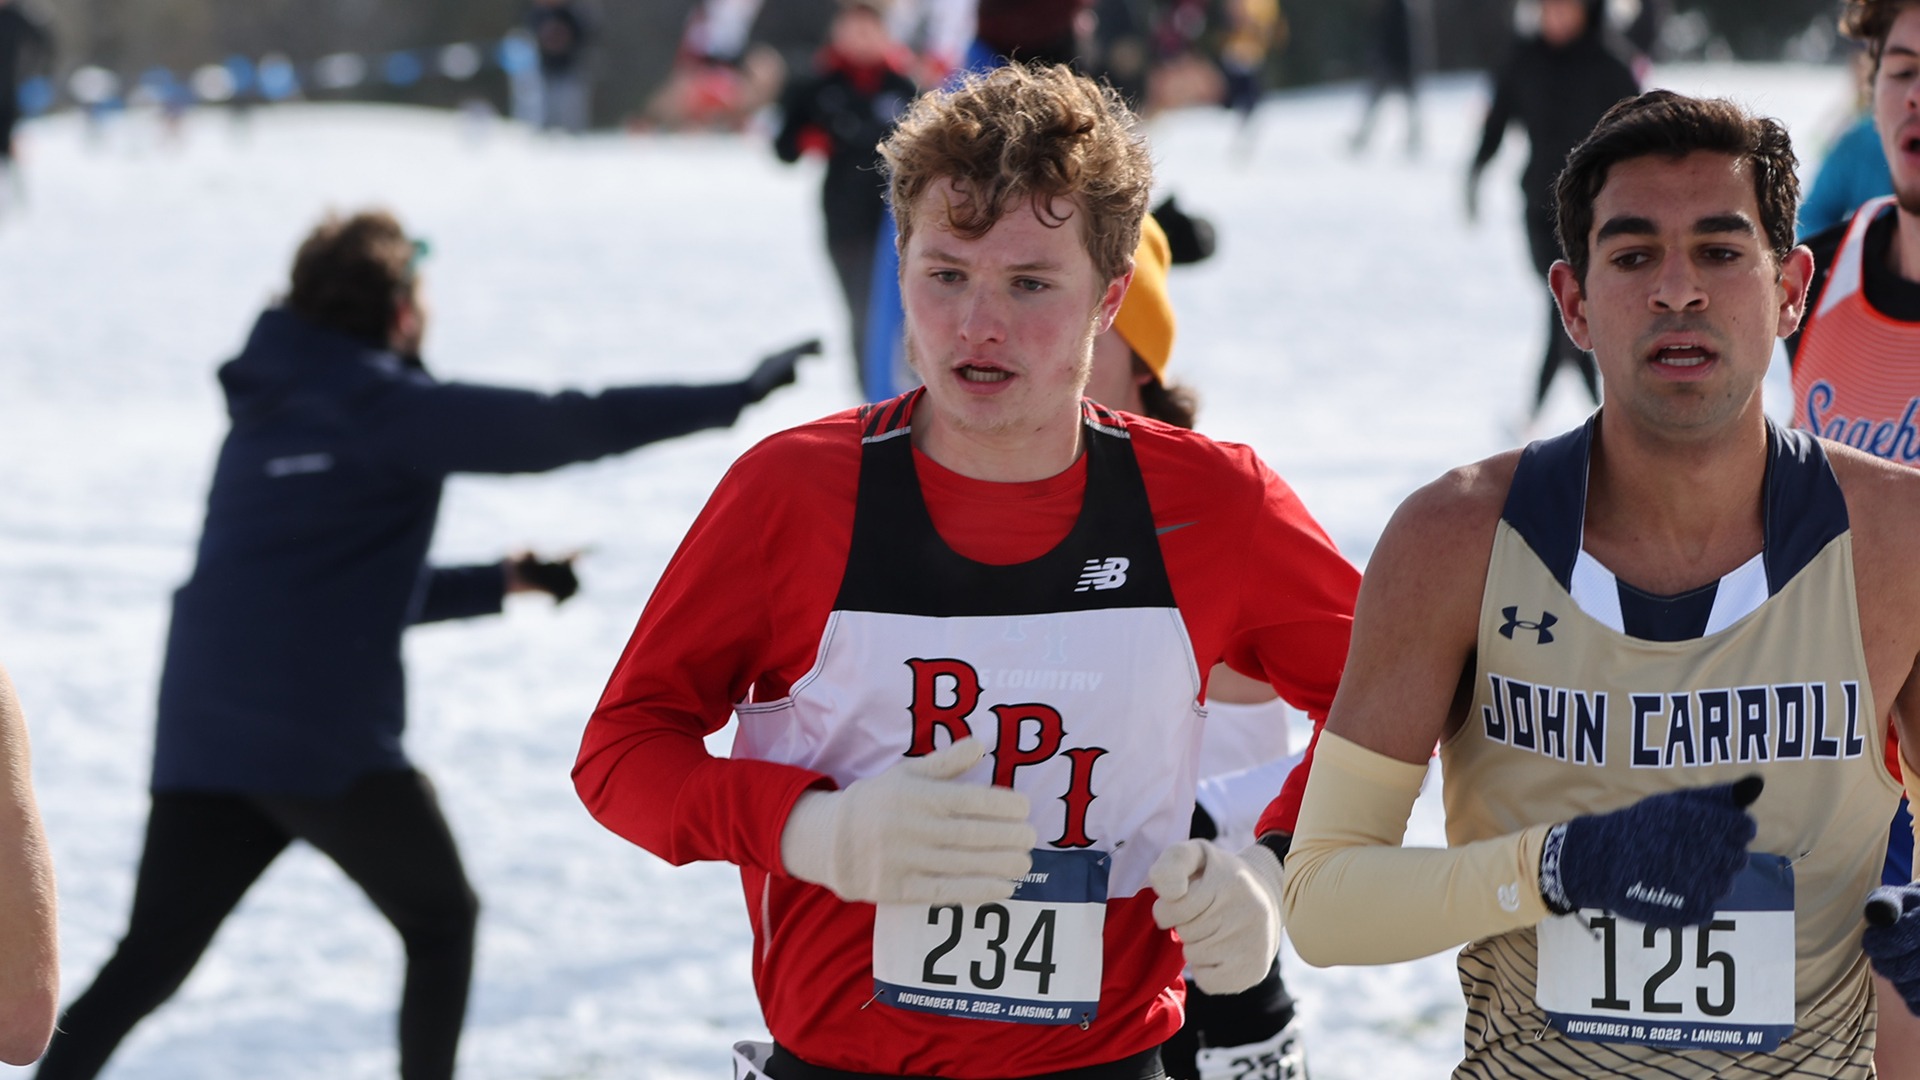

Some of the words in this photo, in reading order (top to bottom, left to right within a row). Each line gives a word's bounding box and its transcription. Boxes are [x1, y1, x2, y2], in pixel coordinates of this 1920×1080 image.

[903, 657, 1108, 849] RPI
[1481, 672, 1608, 767] JOHN
[1628, 680, 1866, 769] CARROLL
[921, 900, 1057, 995] 234
[1589, 915, 1737, 1017] 125
[897, 992, 954, 1010] NOVEMBER
[955, 999, 970, 1013] 19,
[971, 1001, 1001, 1014] 2022
[1008, 1004, 1055, 1020] LANSING,
[1057, 1007, 1072, 1019] MI
[1566, 1020, 1629, 1038] NOVEMBER
[1630, 1025, 1648, 1040] 19,
[1649, 1027, 1682, 1041] 2022
[1690, 1028, 1745, 1046] LANSING,
[1746, 1031, 1764, 1045] MI
